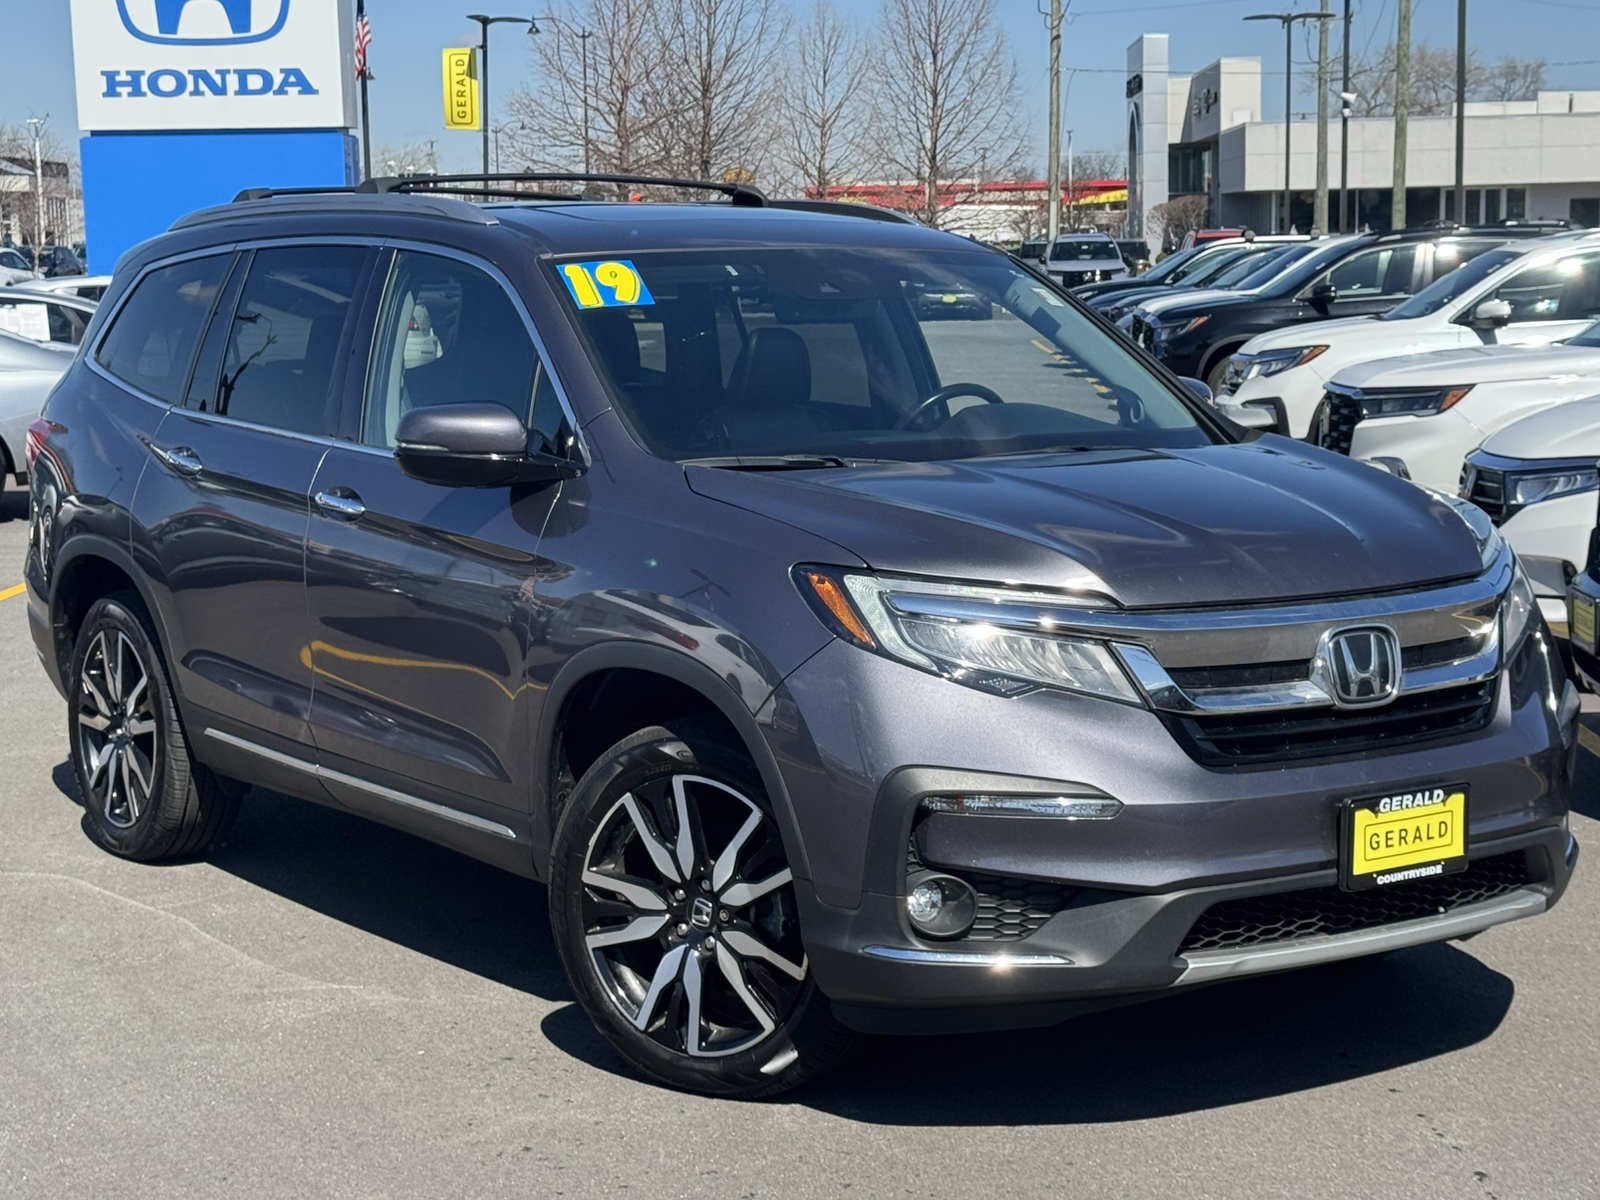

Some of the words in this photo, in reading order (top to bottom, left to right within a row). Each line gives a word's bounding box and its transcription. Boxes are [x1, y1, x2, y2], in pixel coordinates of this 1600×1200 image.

[100, 68, 319, 98] HONDA
[455, 59, 467, 119] GERALD
[564, 262, 641, 307] 19
[1379, 789, 1444, 813] GERALD
[1369, 820, 1448, 851] GERALD
[1376, 864, 1443, 885] COUNTRYSIDE
